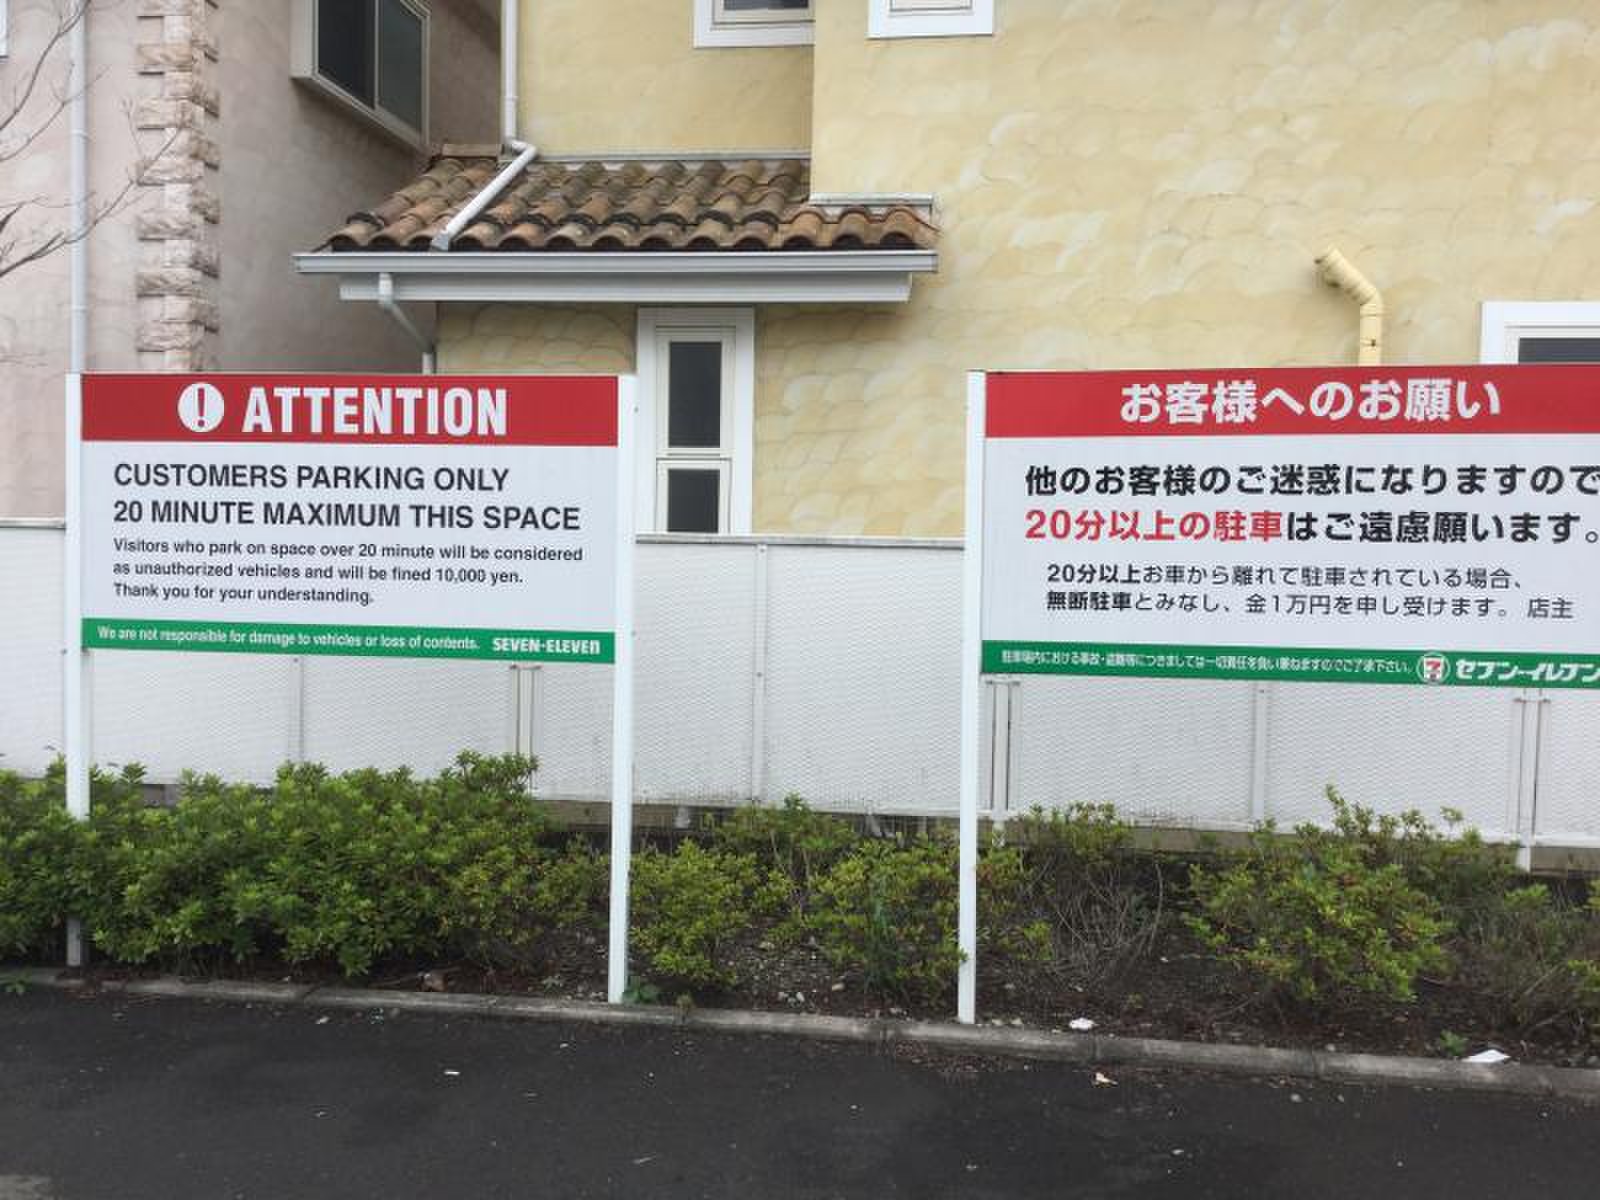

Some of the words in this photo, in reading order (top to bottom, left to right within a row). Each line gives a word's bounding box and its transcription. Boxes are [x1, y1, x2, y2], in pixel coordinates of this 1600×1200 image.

[241, 386, 508, 437] ATTENTION
[1120, 378, 1500, 425] お客様へのお願い
[113, 463, 288, 489] CUSTOMERS
[296, 464, 425, 491] PARKING
[433, 467, 510, 492] ONLY
[1025, 463, 1600, 497] 他のお客様のご迷惑になりますので
[113, 499, 143, 523] 20
[151, 500, 255, 525] MINUTE
[263, 502, 401, 528] MAXIMUM
[408, 505, 474, 529] THIS
[483, 506, 581, 531] SPACE
[1025, 509, 1599, 544] 20分以上の駐車はご遠慮願います。
[113, 537, 170, 553] Visitors
[173, 539, 206, 554] who
[208, 540, 243, 558] park
[245, 544, 267, 556] on
[270, 544, 317, 560] space
[319, 545, 355, 558] over
[358, 544, 377, 557] 20
[381, 544, 435, 559] minute
[438, 545, 466, 559] will
[469, 546, 491, 560] be
[493, 546, 583, 561] considered
[112, 565, 131, 576] as
[134, 561, 234, 577] unauthorized
[237, 563, 301, 578] vehicles
[304, 565, 334, 579] and
[337, 565, 364, 580] will
[367, 566, 388, 580] be
[391, 566, 432, 582] fined
[435, 568, 487, 585] 10,000
[489, 571, 524, 587] yen.
[1047, 563, 1521, 590] 20分以上お車から離れて駐車されている場合、
[113, 582, 159, 598] Thank
[162, 586, 191, 602] you
[193, 585, 215, 600] for
[218, 588, 255, 604] your
[257, 586, 374, 608] understanding.
[1046, 590, 1507, 617] 無断駐車とみなし、金1万円を申し受けます。
[1526, 597, 1574, 619] 店主
[97, 625, 116, 640] We
[118, 628, 137, 640] are
[139, 628, 159, 641] not
[229, 629, 246, 643] for
[249, 631, 296, 648] damage
[297, 633, 311, 645] to
[312, 632, 362, 647] vehicles
[365, 637, 378, 647] or
[380, 634, 406, 648] loss
[408, 635, 422, 649] of
